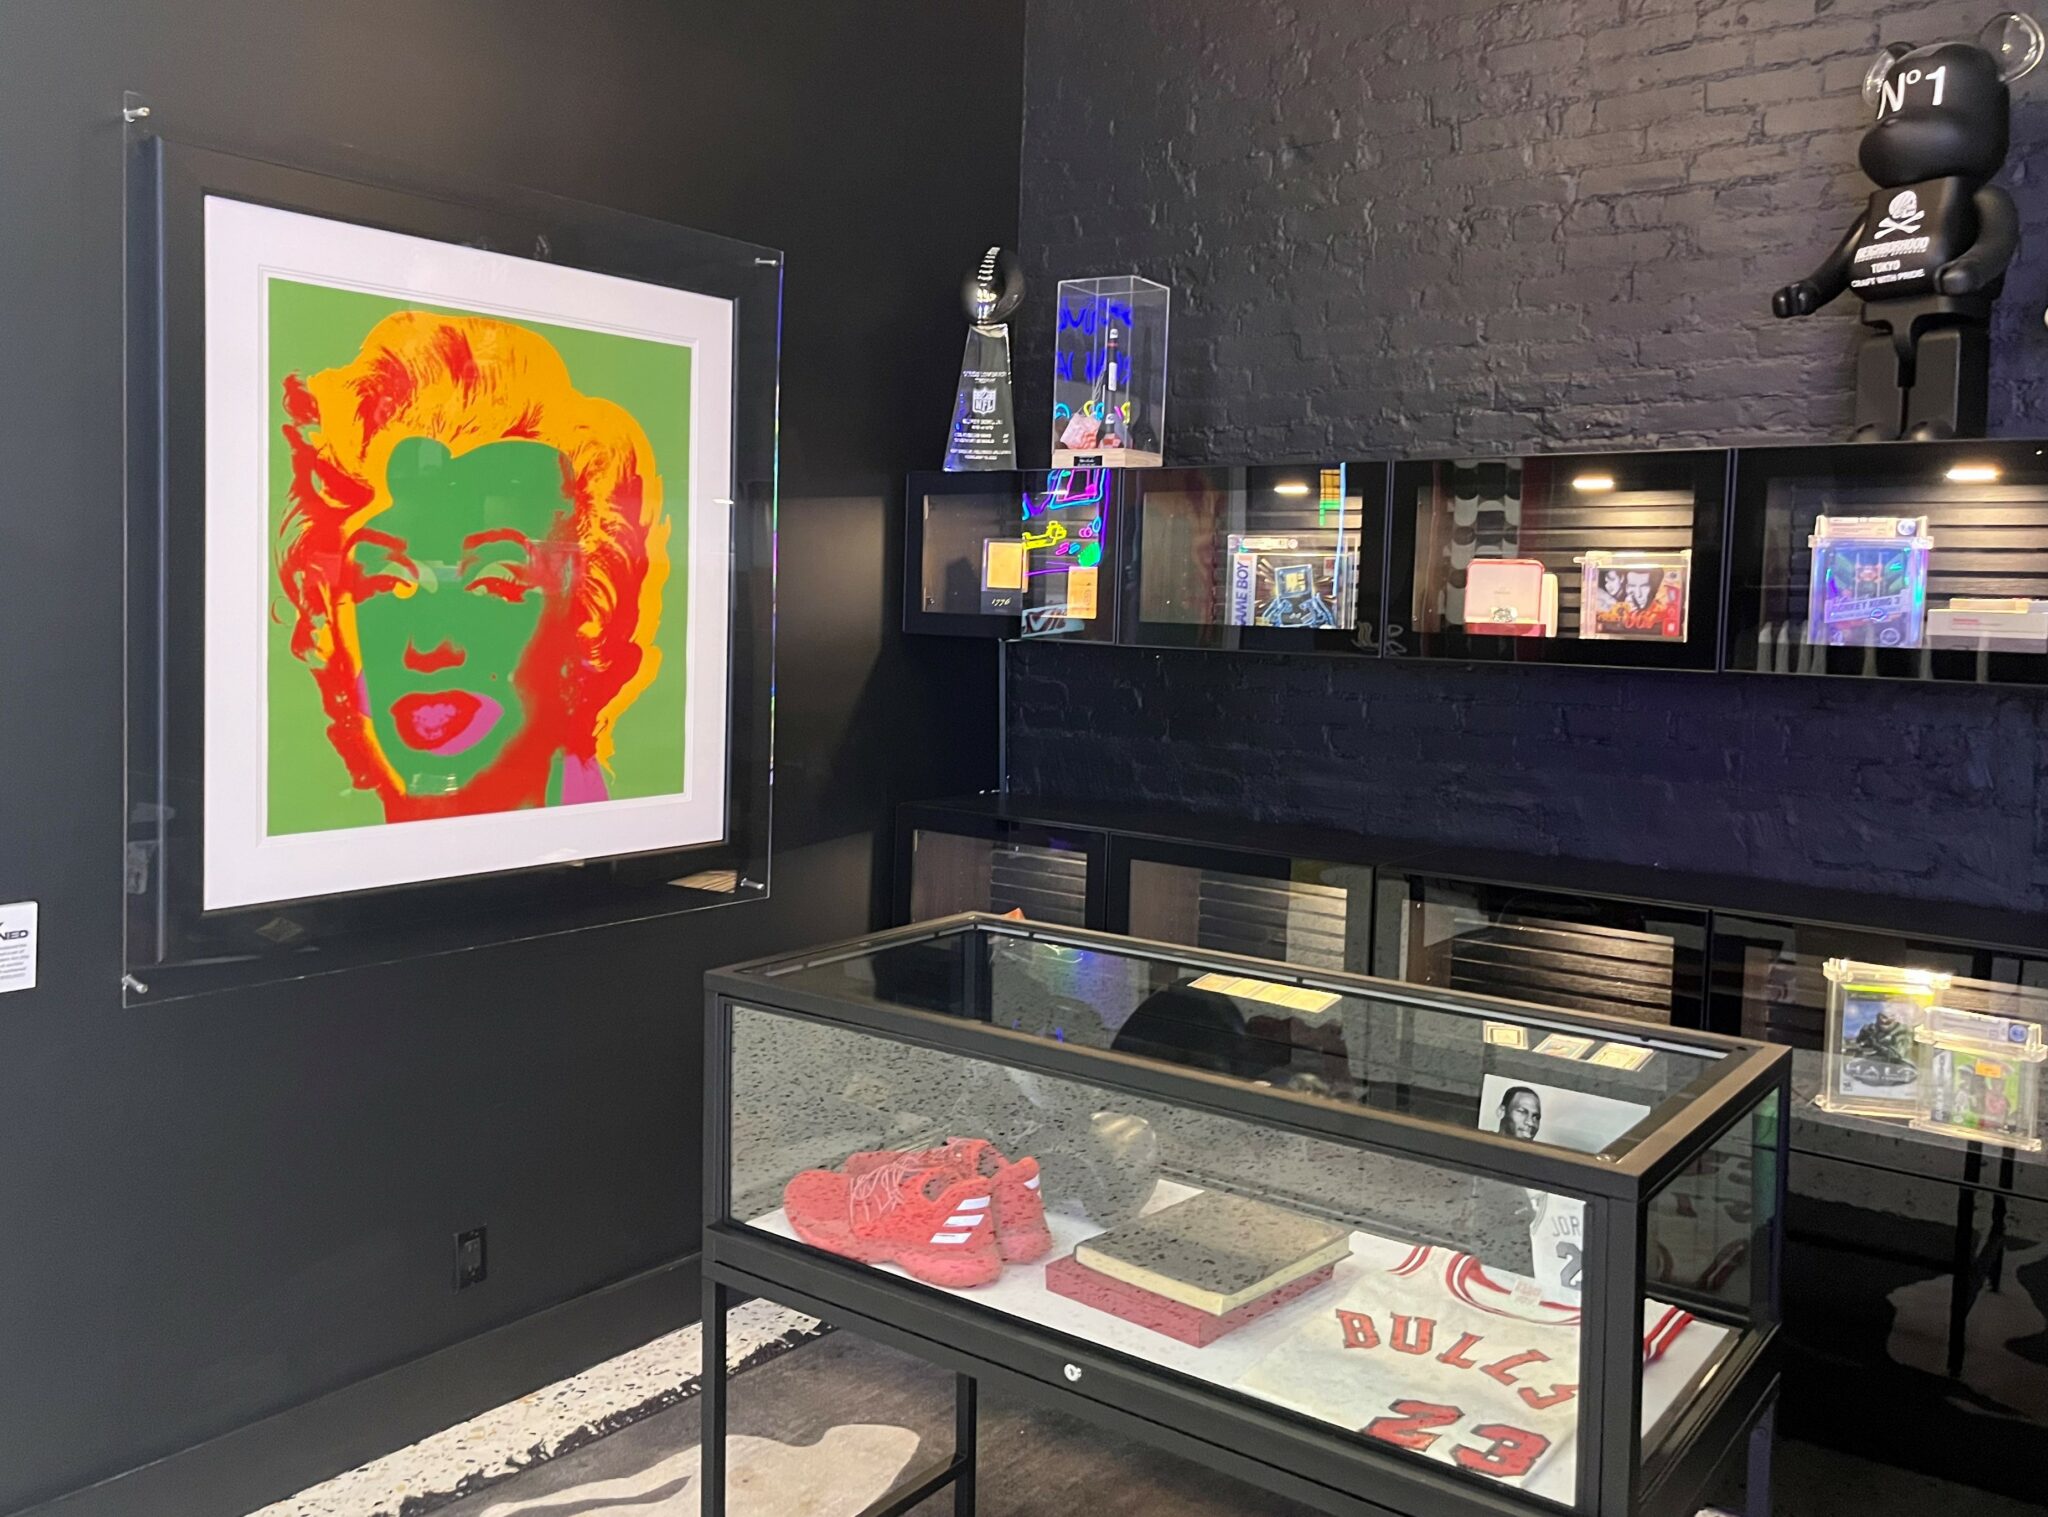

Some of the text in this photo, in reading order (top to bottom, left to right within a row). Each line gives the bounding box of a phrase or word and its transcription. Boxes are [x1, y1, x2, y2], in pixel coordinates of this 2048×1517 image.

[974, 400, 994, 412] NFL
[1236, 561, 1249, 589] BOY
[991, 597, 1011, 607] 1776
[1358, 1398, 1551, 1477] 23
